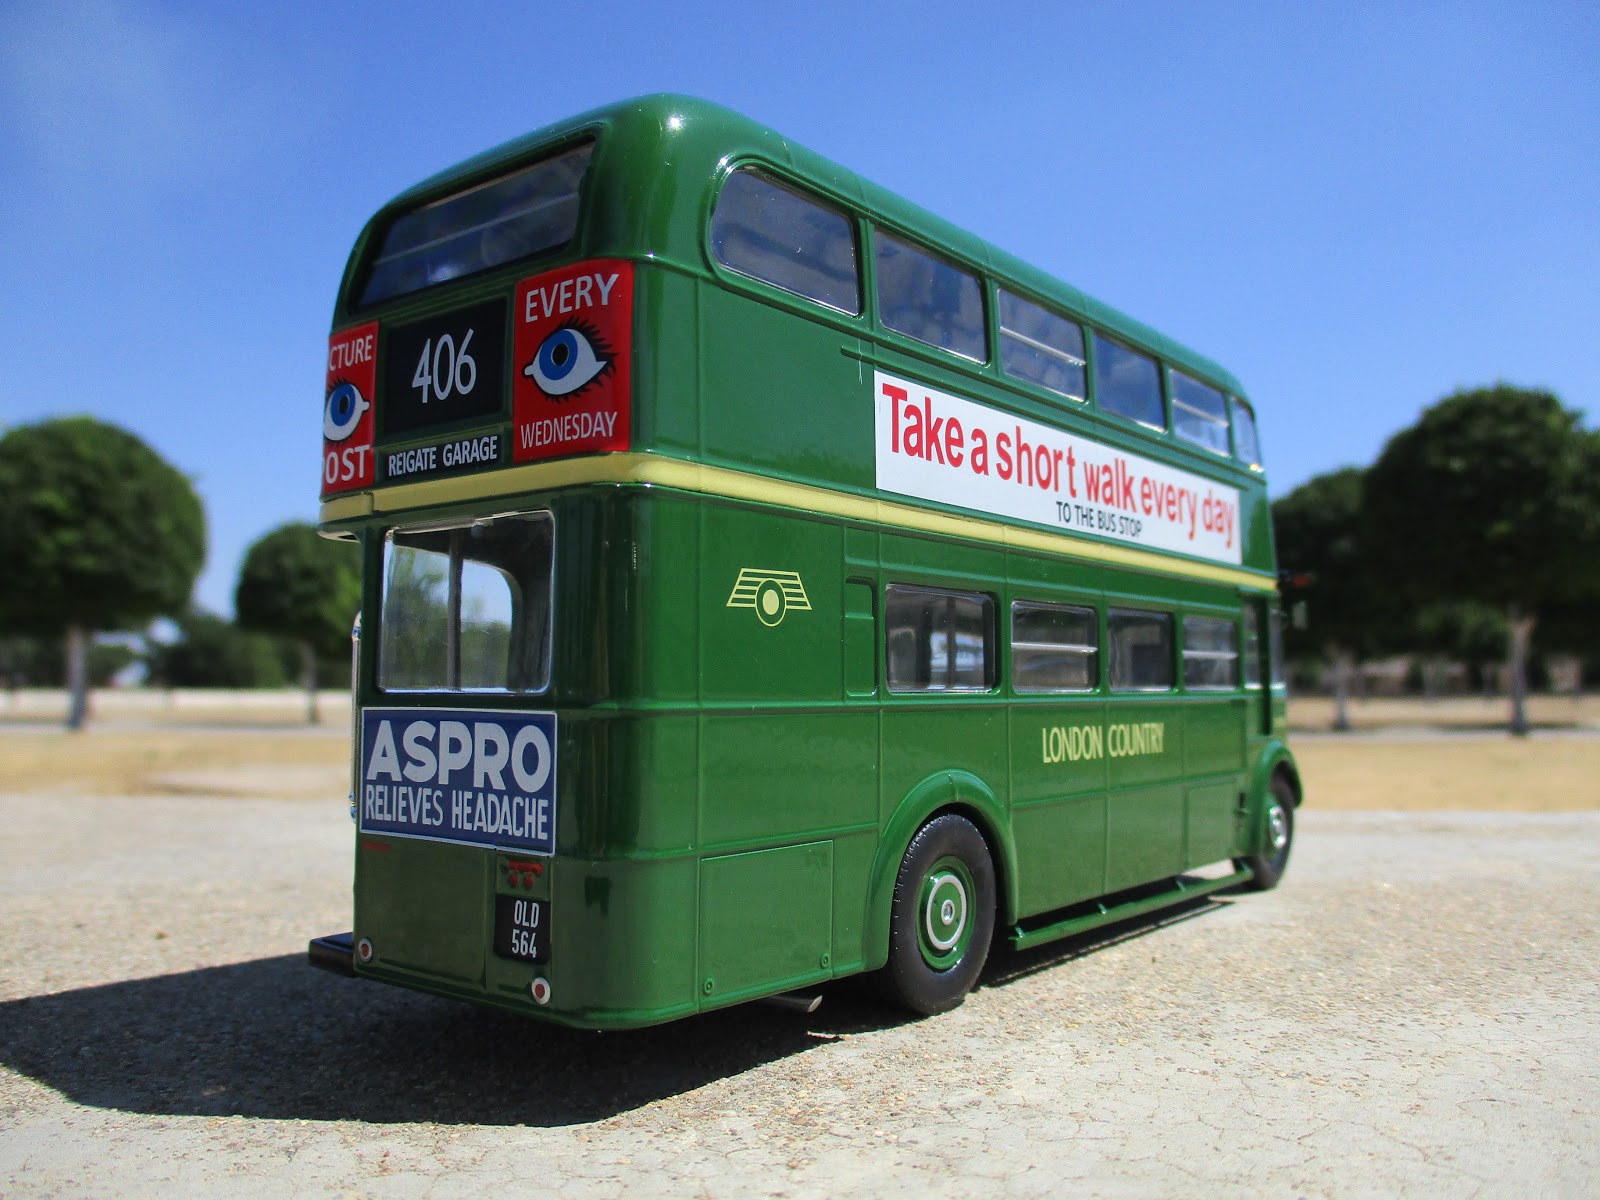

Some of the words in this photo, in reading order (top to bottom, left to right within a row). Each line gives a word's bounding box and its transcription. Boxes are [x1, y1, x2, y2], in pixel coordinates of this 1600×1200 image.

[525, 273, 619, 323] EVERY
[330, 334, 373, 371] CTURE
[411, 328, 477, 403] 406
[520, 411, 618, 449] WEDNESDAY
[323, 444, 370, 484] OST
[388, 446, 437, 477] REIGATE
[442, 435, 498, 467] GARAGE
[882, 382, 964, 468] Take
[970, 428, 989, 476] a
[996, 425, 1077, 498] short
[1083, 457, 1137, 513] walk
[1141, 476, 1197, 541] every
[1202, 489, 1234, 549] day
[1056, 501, 1072, 524] TO
[1075, 504, 1094, 528] THE
[1098, 510, 1116, 533] BUS
[1118, 515, 1142, 538] STOP
[366, 719, 551, 793] ASPRO
[1042, 724, 1104, 764] LONDON
[1107, 722, 1164, 758] COUNTRY
[365, 784, 444, 827] RELIEVES
[451, 789, 549, 840] HEADACHE
[514, 900, 540, 928] OLD
[511, 928, 537, 958] 564
